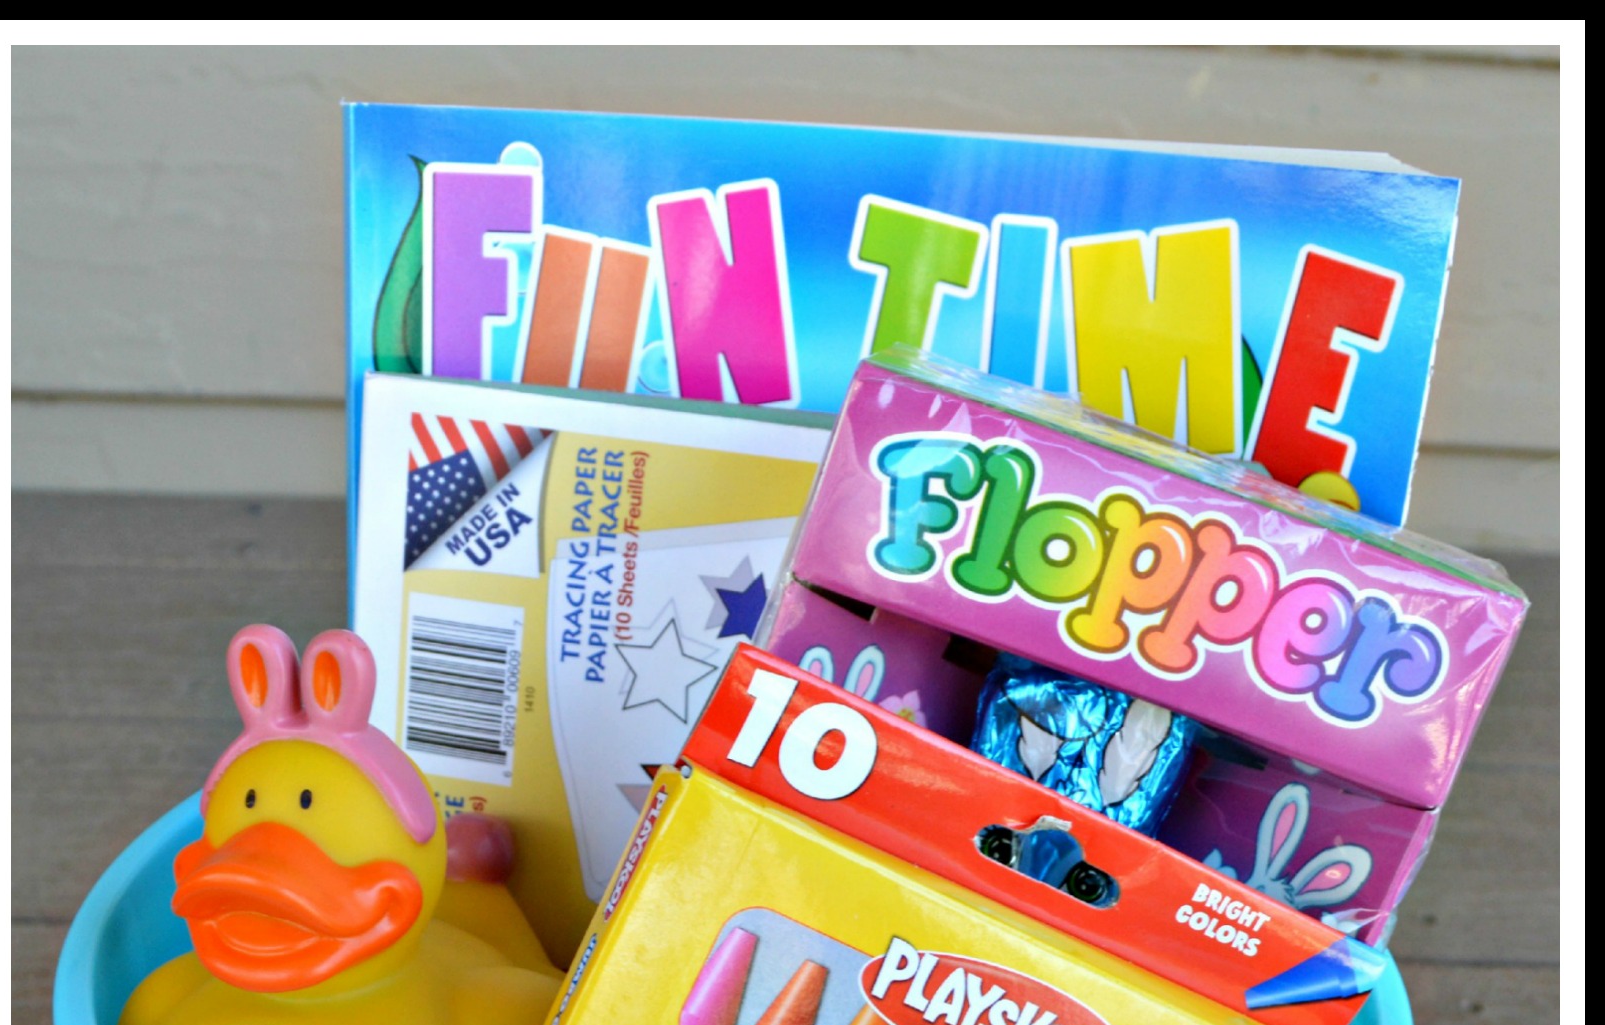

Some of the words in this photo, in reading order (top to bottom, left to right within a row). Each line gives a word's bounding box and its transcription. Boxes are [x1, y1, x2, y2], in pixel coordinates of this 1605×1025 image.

[422, 162, 800, 408] FUN
[849, 193, 1405, 492] TIME
[445, 506, 499, 555] MADE
[495, 482, 521, 513] IN
[572, 447, 597, 533] PAPER
[596, 450, 625, 557] TRACER
[465, 510, 533, 566] USA
[616, 541, 639, 607] Sheets
[868, 431, 1450, 728] Flopper
[561, 541, 590, 662] TRACING
[585, 590, 612, 683] PAPIER
[614, 612, 633, 641] (10
[725, 668, 878, 802] 10
[604, 784, 668, 914] PLAYSKOOL
[1176, 904, 1262, 957] COLORS
[1191, 882, 1271, 932] BRIGHT
